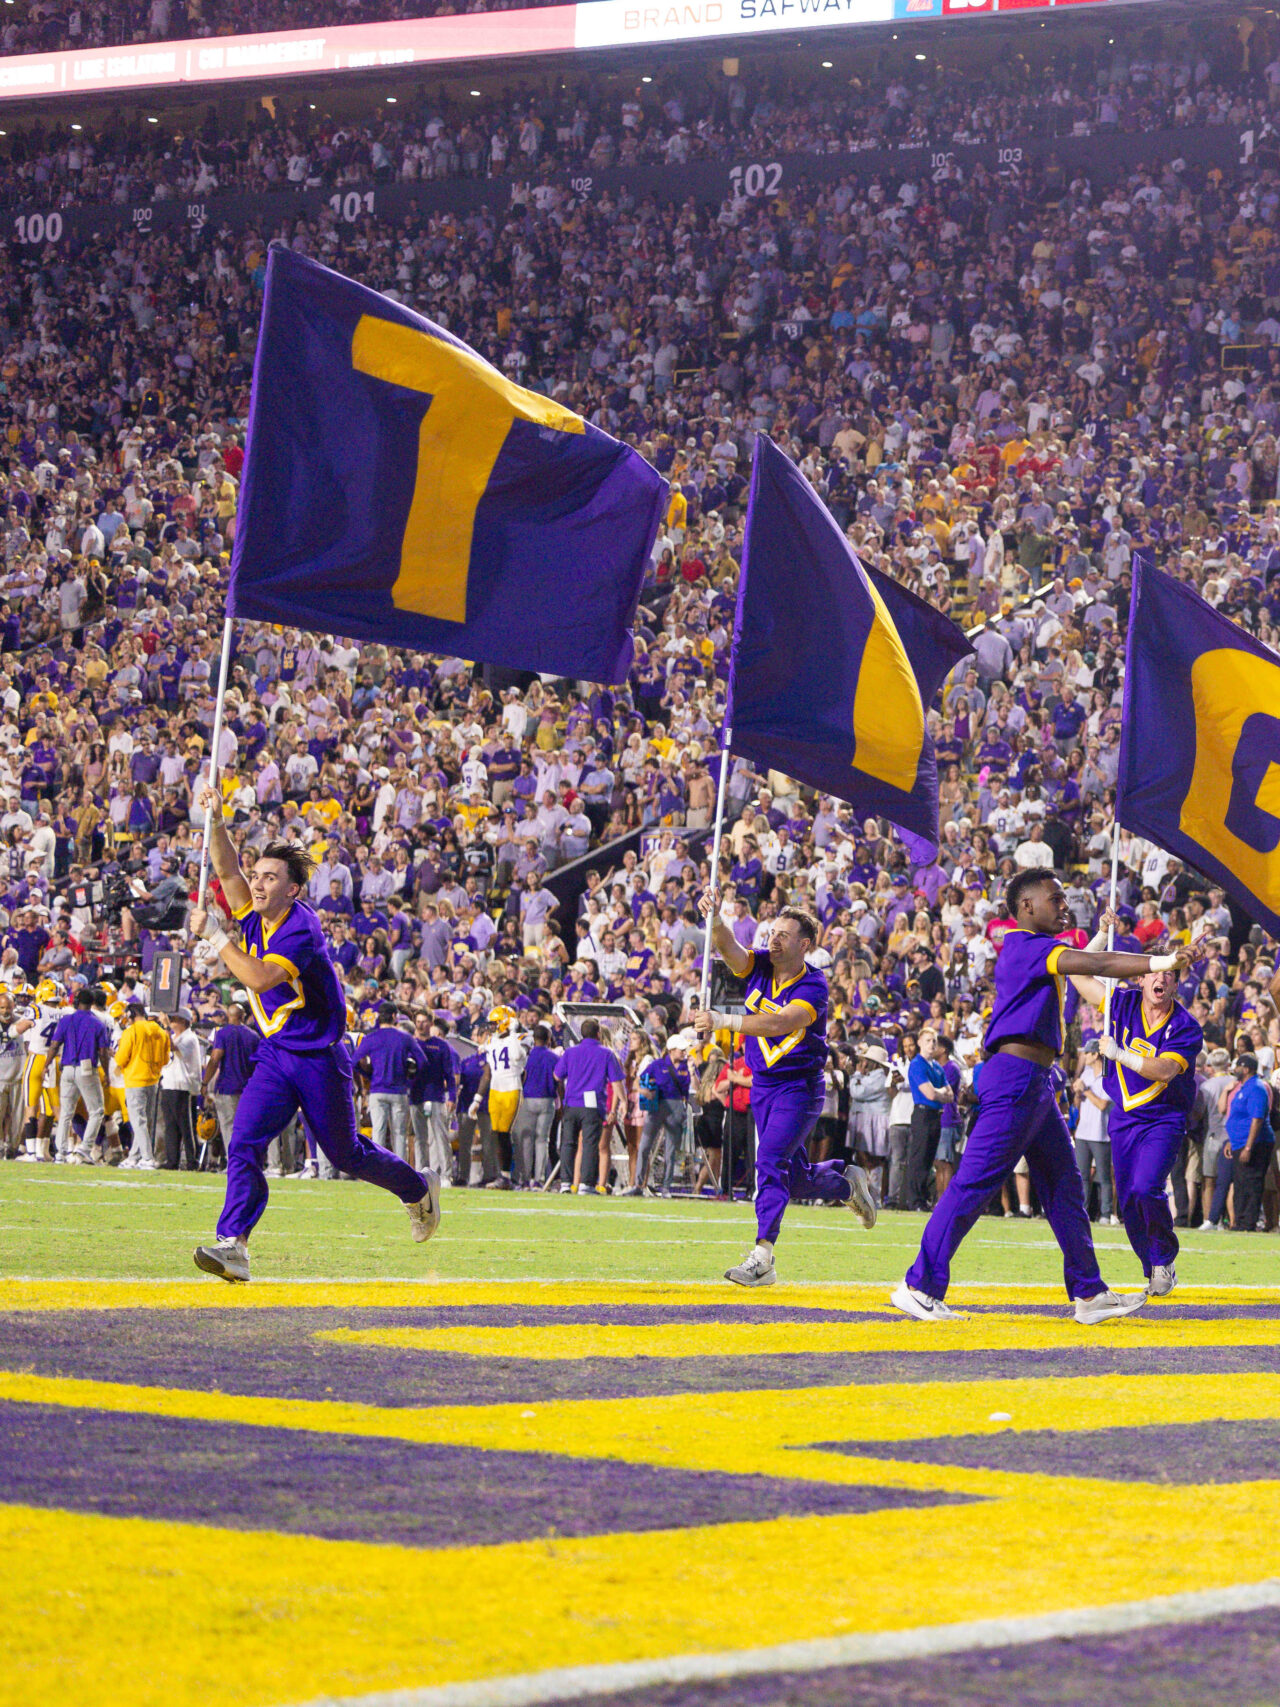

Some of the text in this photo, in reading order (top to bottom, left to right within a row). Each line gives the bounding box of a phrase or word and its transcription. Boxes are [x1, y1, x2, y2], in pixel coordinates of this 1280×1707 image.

[624, 2, 722, 30] BRAND
[998, 148, 1022, 163] 103
[572, 177, 593, 191] 102
[729, 162, 783, 198] 102
[133, 207, 153, 222] 100
[187, 204, 206, 219] 101
[329, 191, 375, 223] 101
[14, 212, 63, 245] 100
[352, 313, 586, 624] T
[776, 854, 787, 872] 9
[1145, 858, 1158, 873] 10
[158, 957, 171, 990] 1
[745, 988, 784, 1014] LS
[492, 1046, 511, 1070] 14
